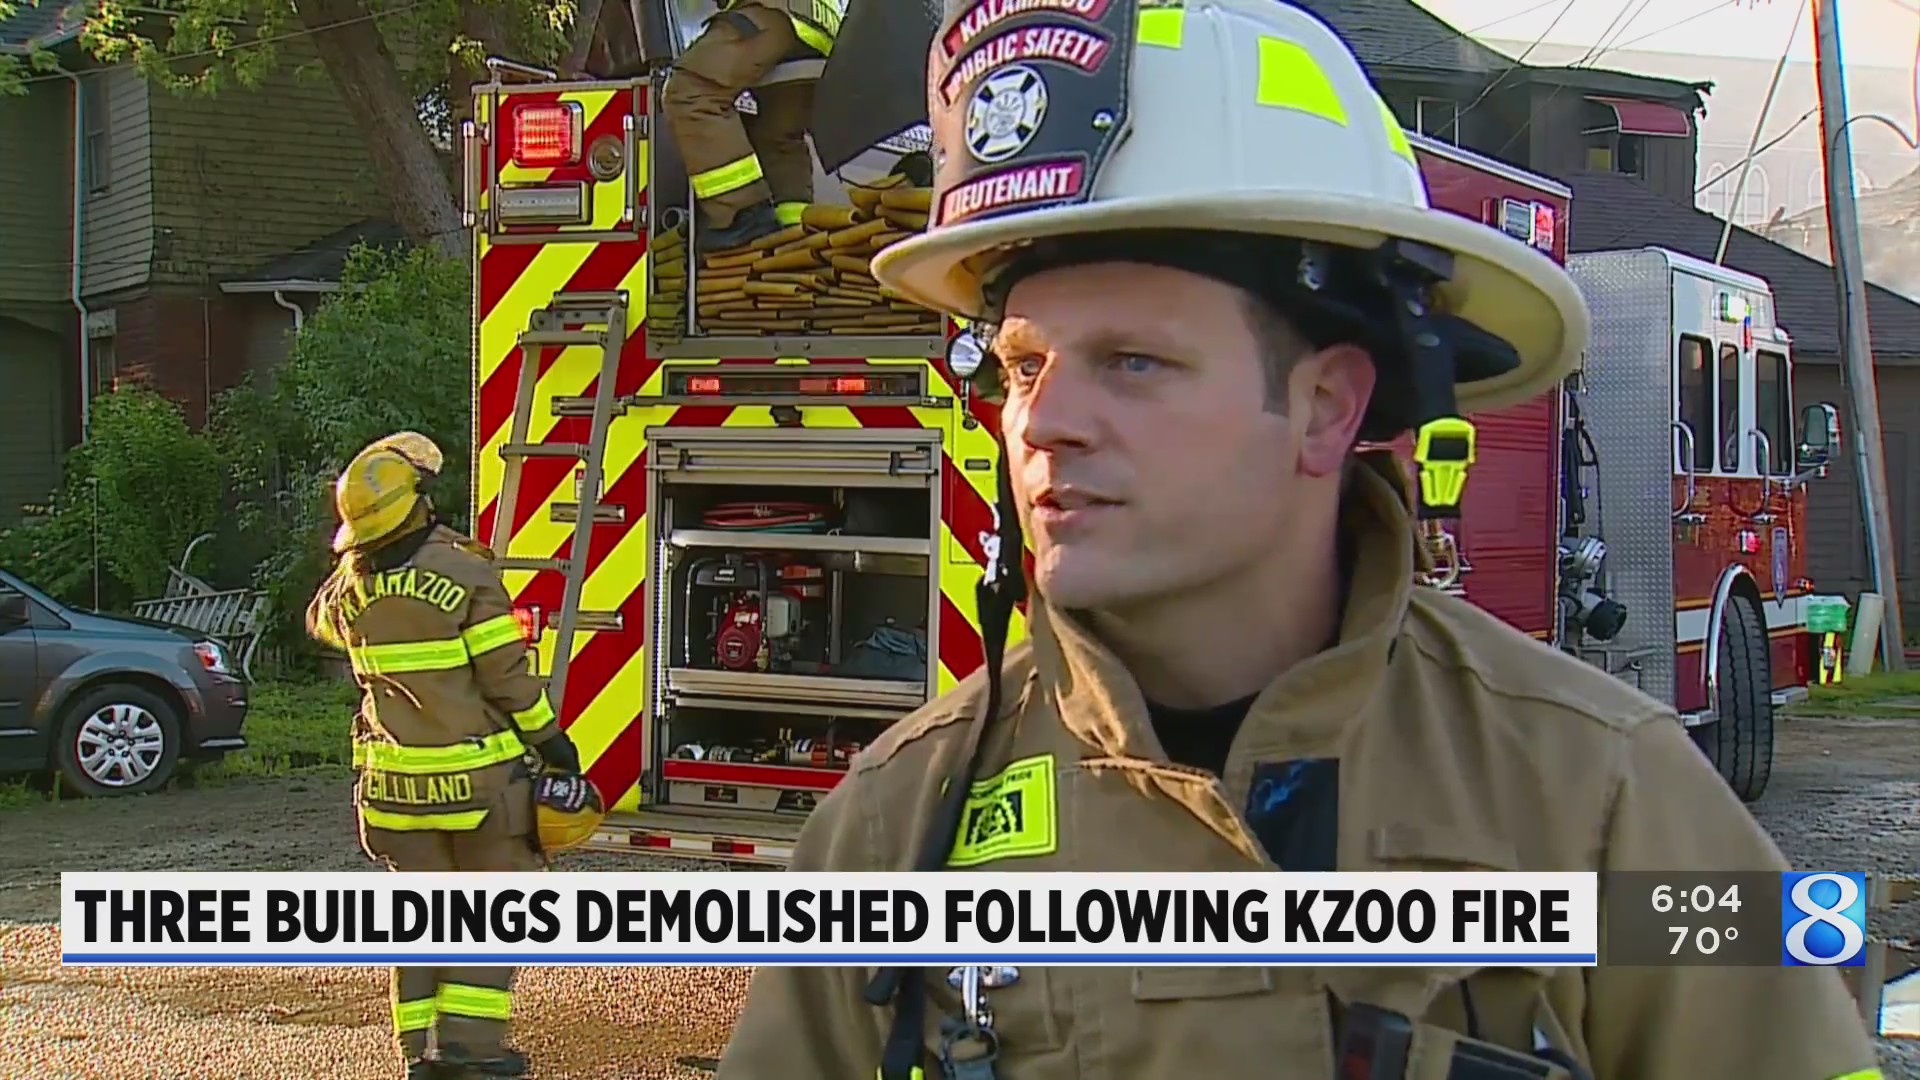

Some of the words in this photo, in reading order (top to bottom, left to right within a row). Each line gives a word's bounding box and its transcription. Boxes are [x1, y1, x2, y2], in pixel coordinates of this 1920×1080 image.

[948, 33, 1018, 97] PUBLIC
[1023, 27, 1103, 66] SAFETY
[950, 167, 1073, 219] LIEUTENANT
[341, 567, 466, 621] KLAMAZOO
[367, 773, 472, 805] GILLILAND
